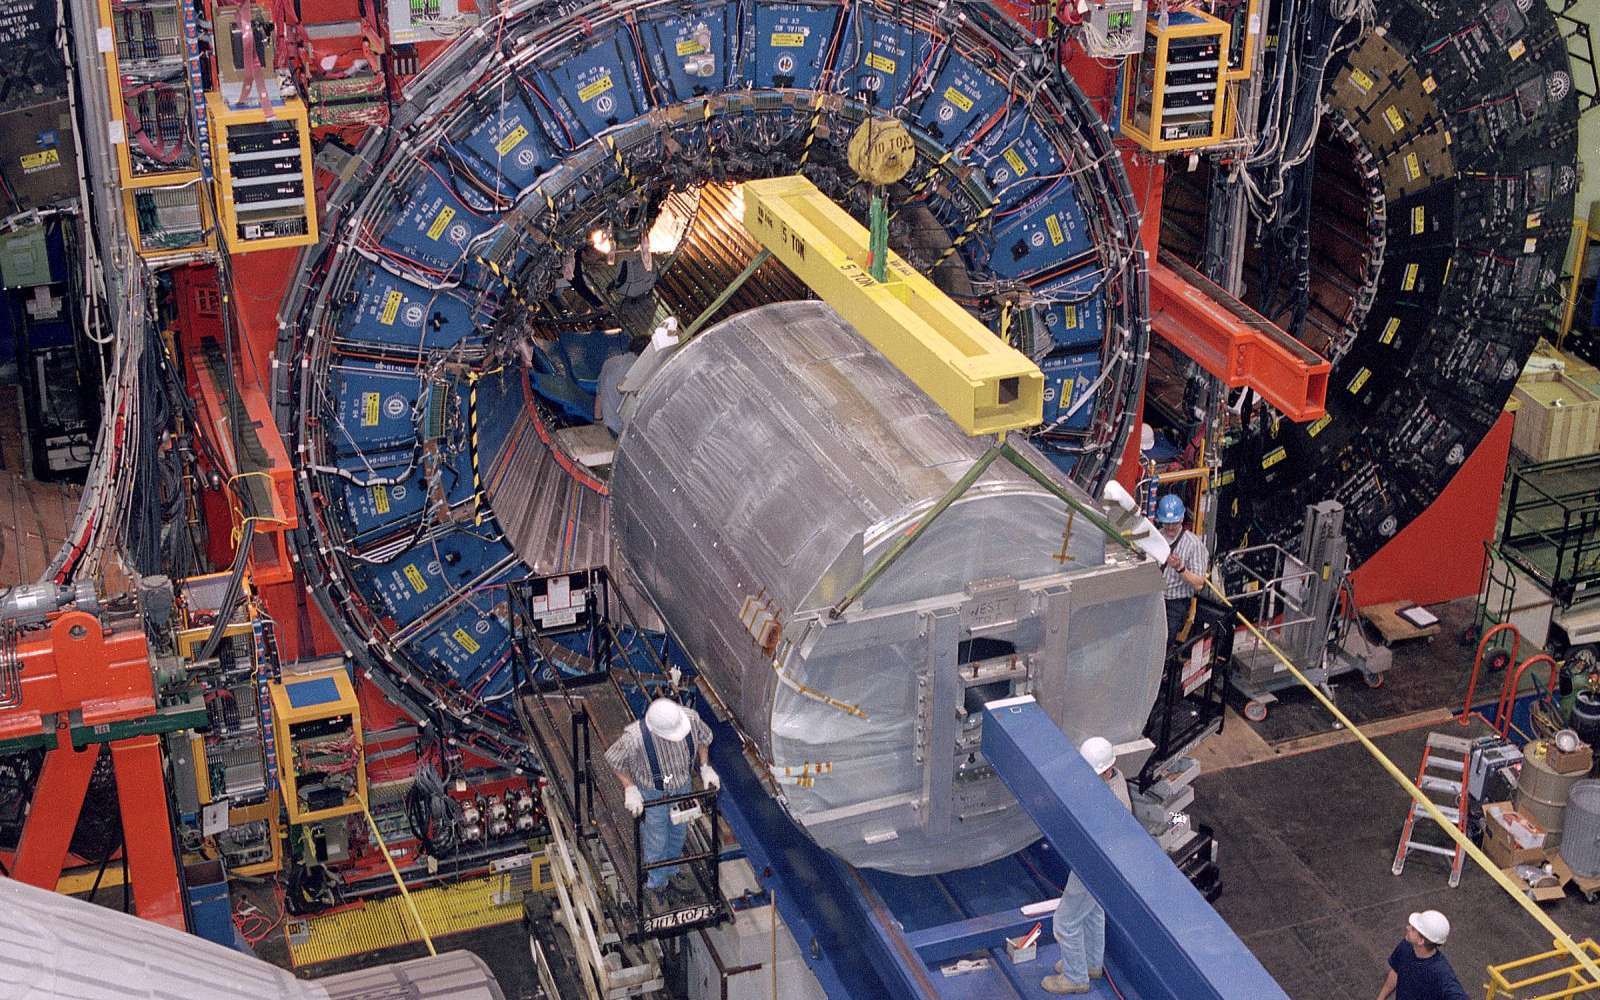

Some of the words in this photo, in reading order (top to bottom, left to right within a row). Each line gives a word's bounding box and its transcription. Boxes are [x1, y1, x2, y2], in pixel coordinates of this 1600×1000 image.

[874, 142, 885, 155] 10
[890, 134, 910, 150] TON
[782, 226, 787, 243] 5
[791, 234, 805, 261] TON
